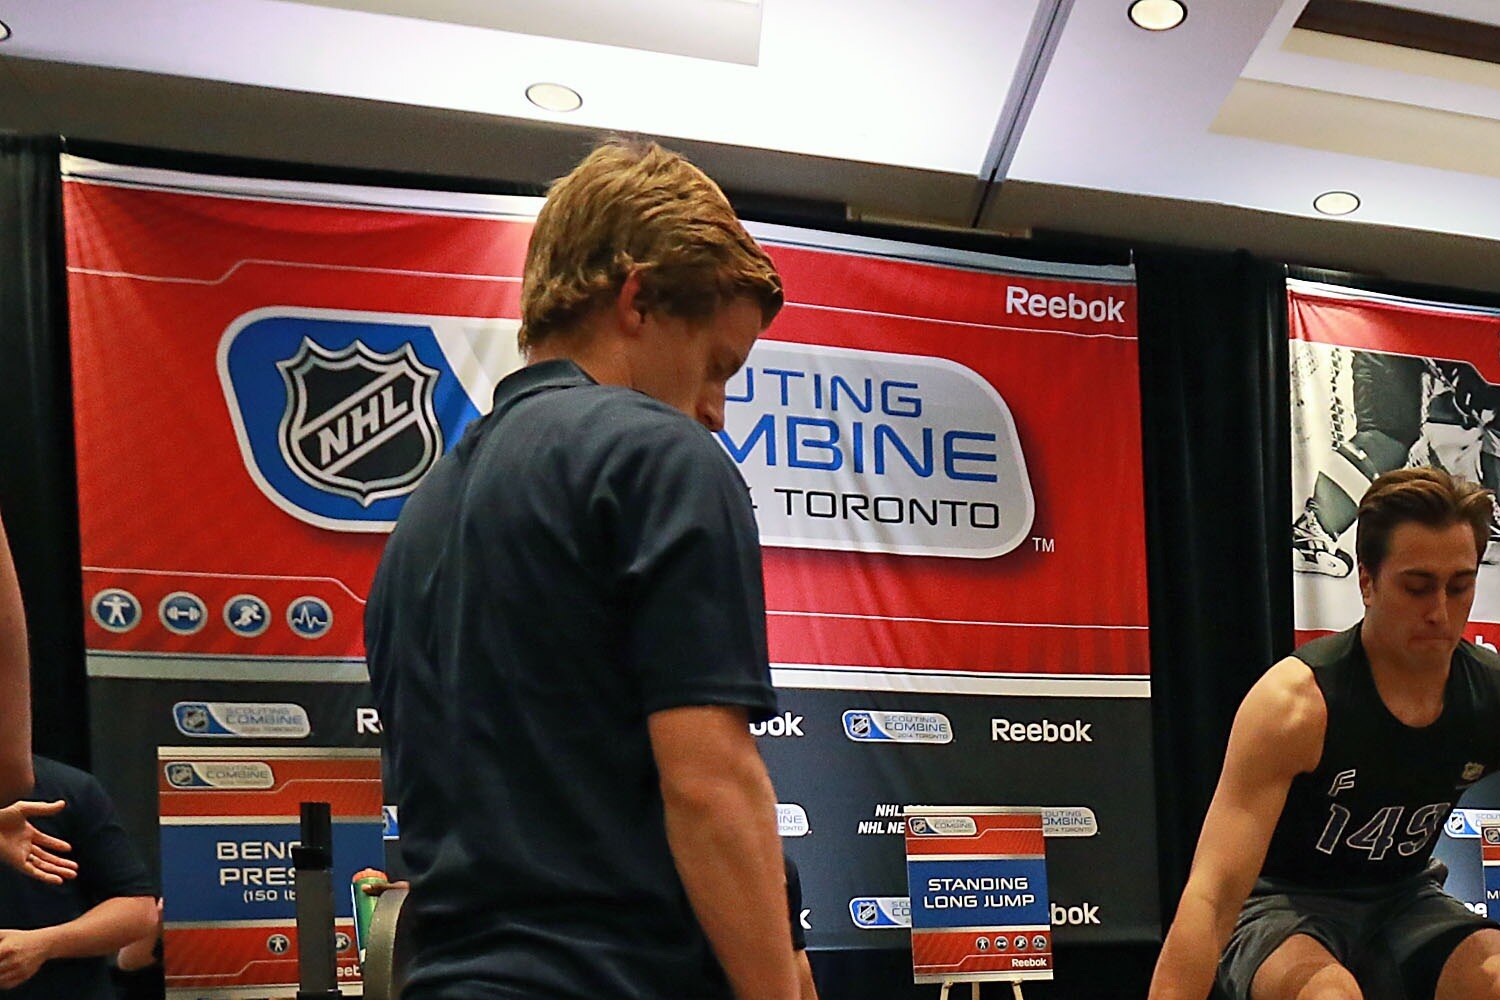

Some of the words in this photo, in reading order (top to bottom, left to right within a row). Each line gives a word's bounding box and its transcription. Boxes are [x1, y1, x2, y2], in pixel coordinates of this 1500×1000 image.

[1005, 286, 1126, 323] Reebok
[725, 366, 922, 418] UTING
[316, 385, 409, 466] NHL
[717, 414, 998, 484] MBINE
[774, 488, 1000, 530] TORONTO
[1032, 537, 1055, 553] TM
[885, 722, 947, 733] COMBINE
[992, 718, 1093, 743] Reebok
[1328, 769, 1356, 797] F
[858, 822, 885, 834] NHL
[1043, 816, 1092, 826] OMBINE
[1315, 802, 1450, 860] 149
[217, 842, 302, 860] BEN
[928, 877, 1028, 891] STANDING
[243, 889, 278, 903] (150
[924, 895, 978, 909] LONG
[983, 895, 1035, 908] JUMP
[1051, 903, 1101, 925] bok
[1012, 958, 1047, 968] Reebok
